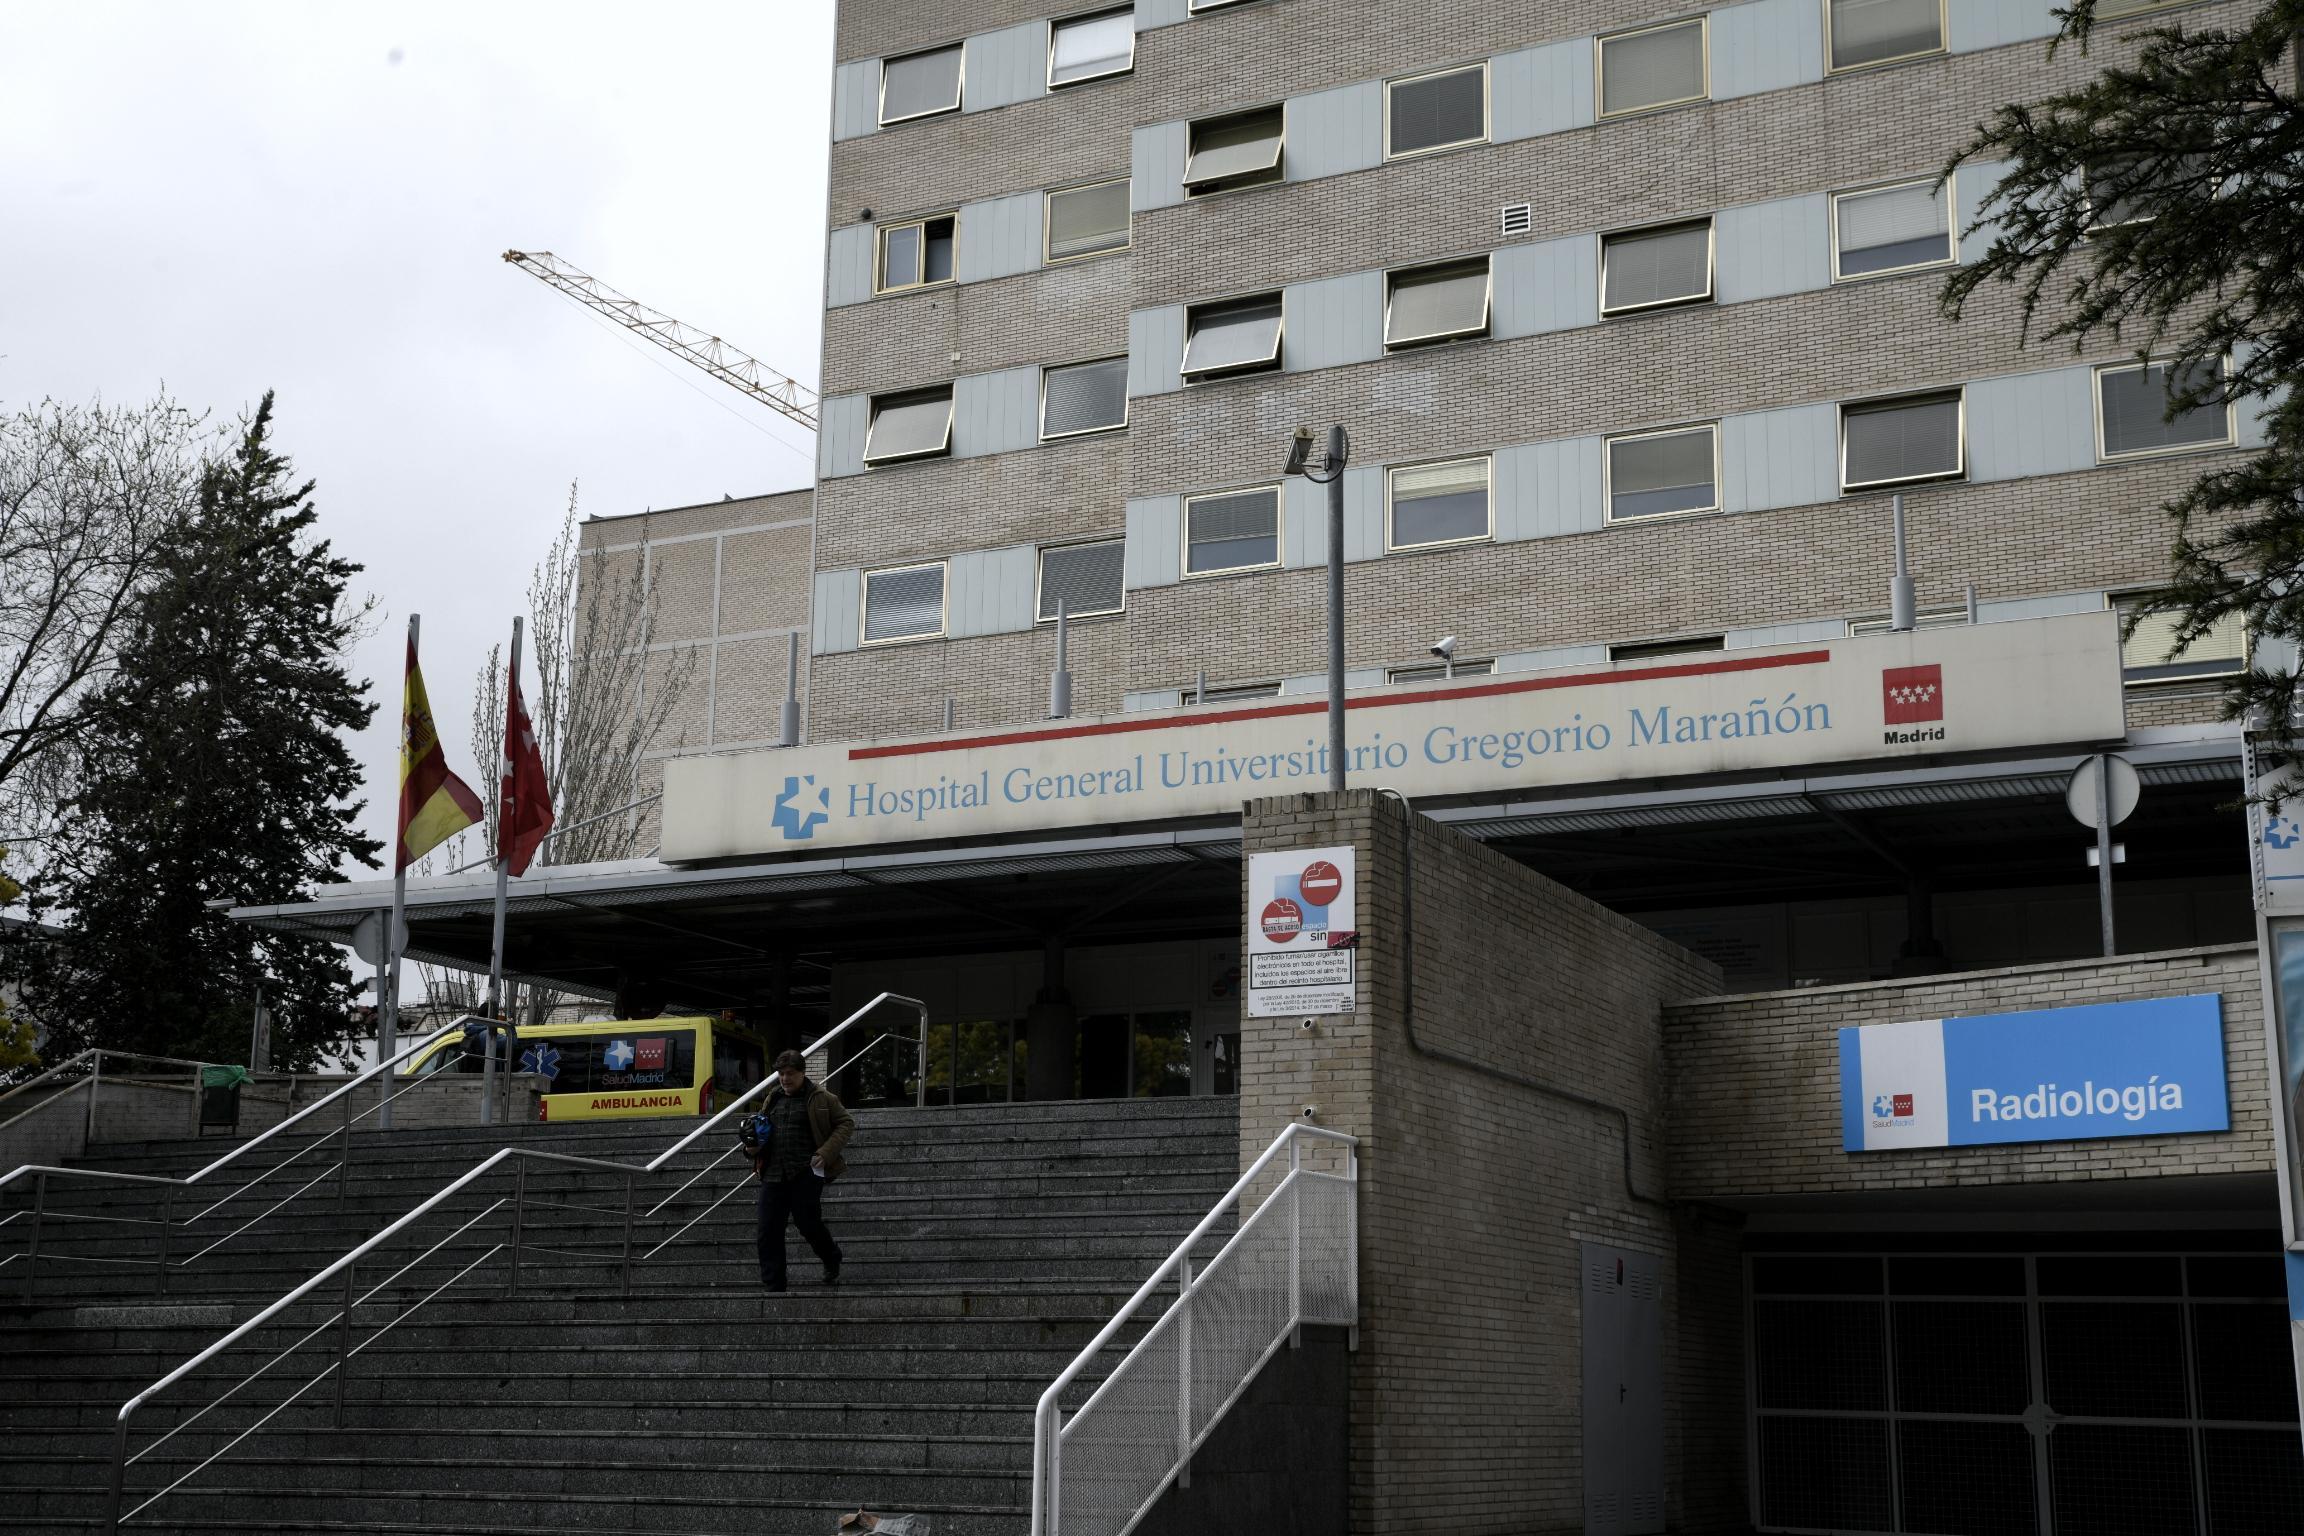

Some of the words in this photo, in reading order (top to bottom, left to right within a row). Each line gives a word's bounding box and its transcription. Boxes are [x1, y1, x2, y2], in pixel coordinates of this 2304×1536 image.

[1884, 727, 1945, 745] Madrid
[847, 771, 990, 821] Hospital
[1003, 756, 1144, 804] General
[1423, 713, 1612, 769] Gregorio
[1627, 692, 1832, 747] Marañón
[1310, 929, 1327, 941] sin
[1257, 954, 1285, 962] Prohibido
[601, 1072, 664, 1086] SaludMadrid
[590, 1095, 683, 1110] AMBULANCIA
[1971, 1075, 2183, 1122] Radiología
